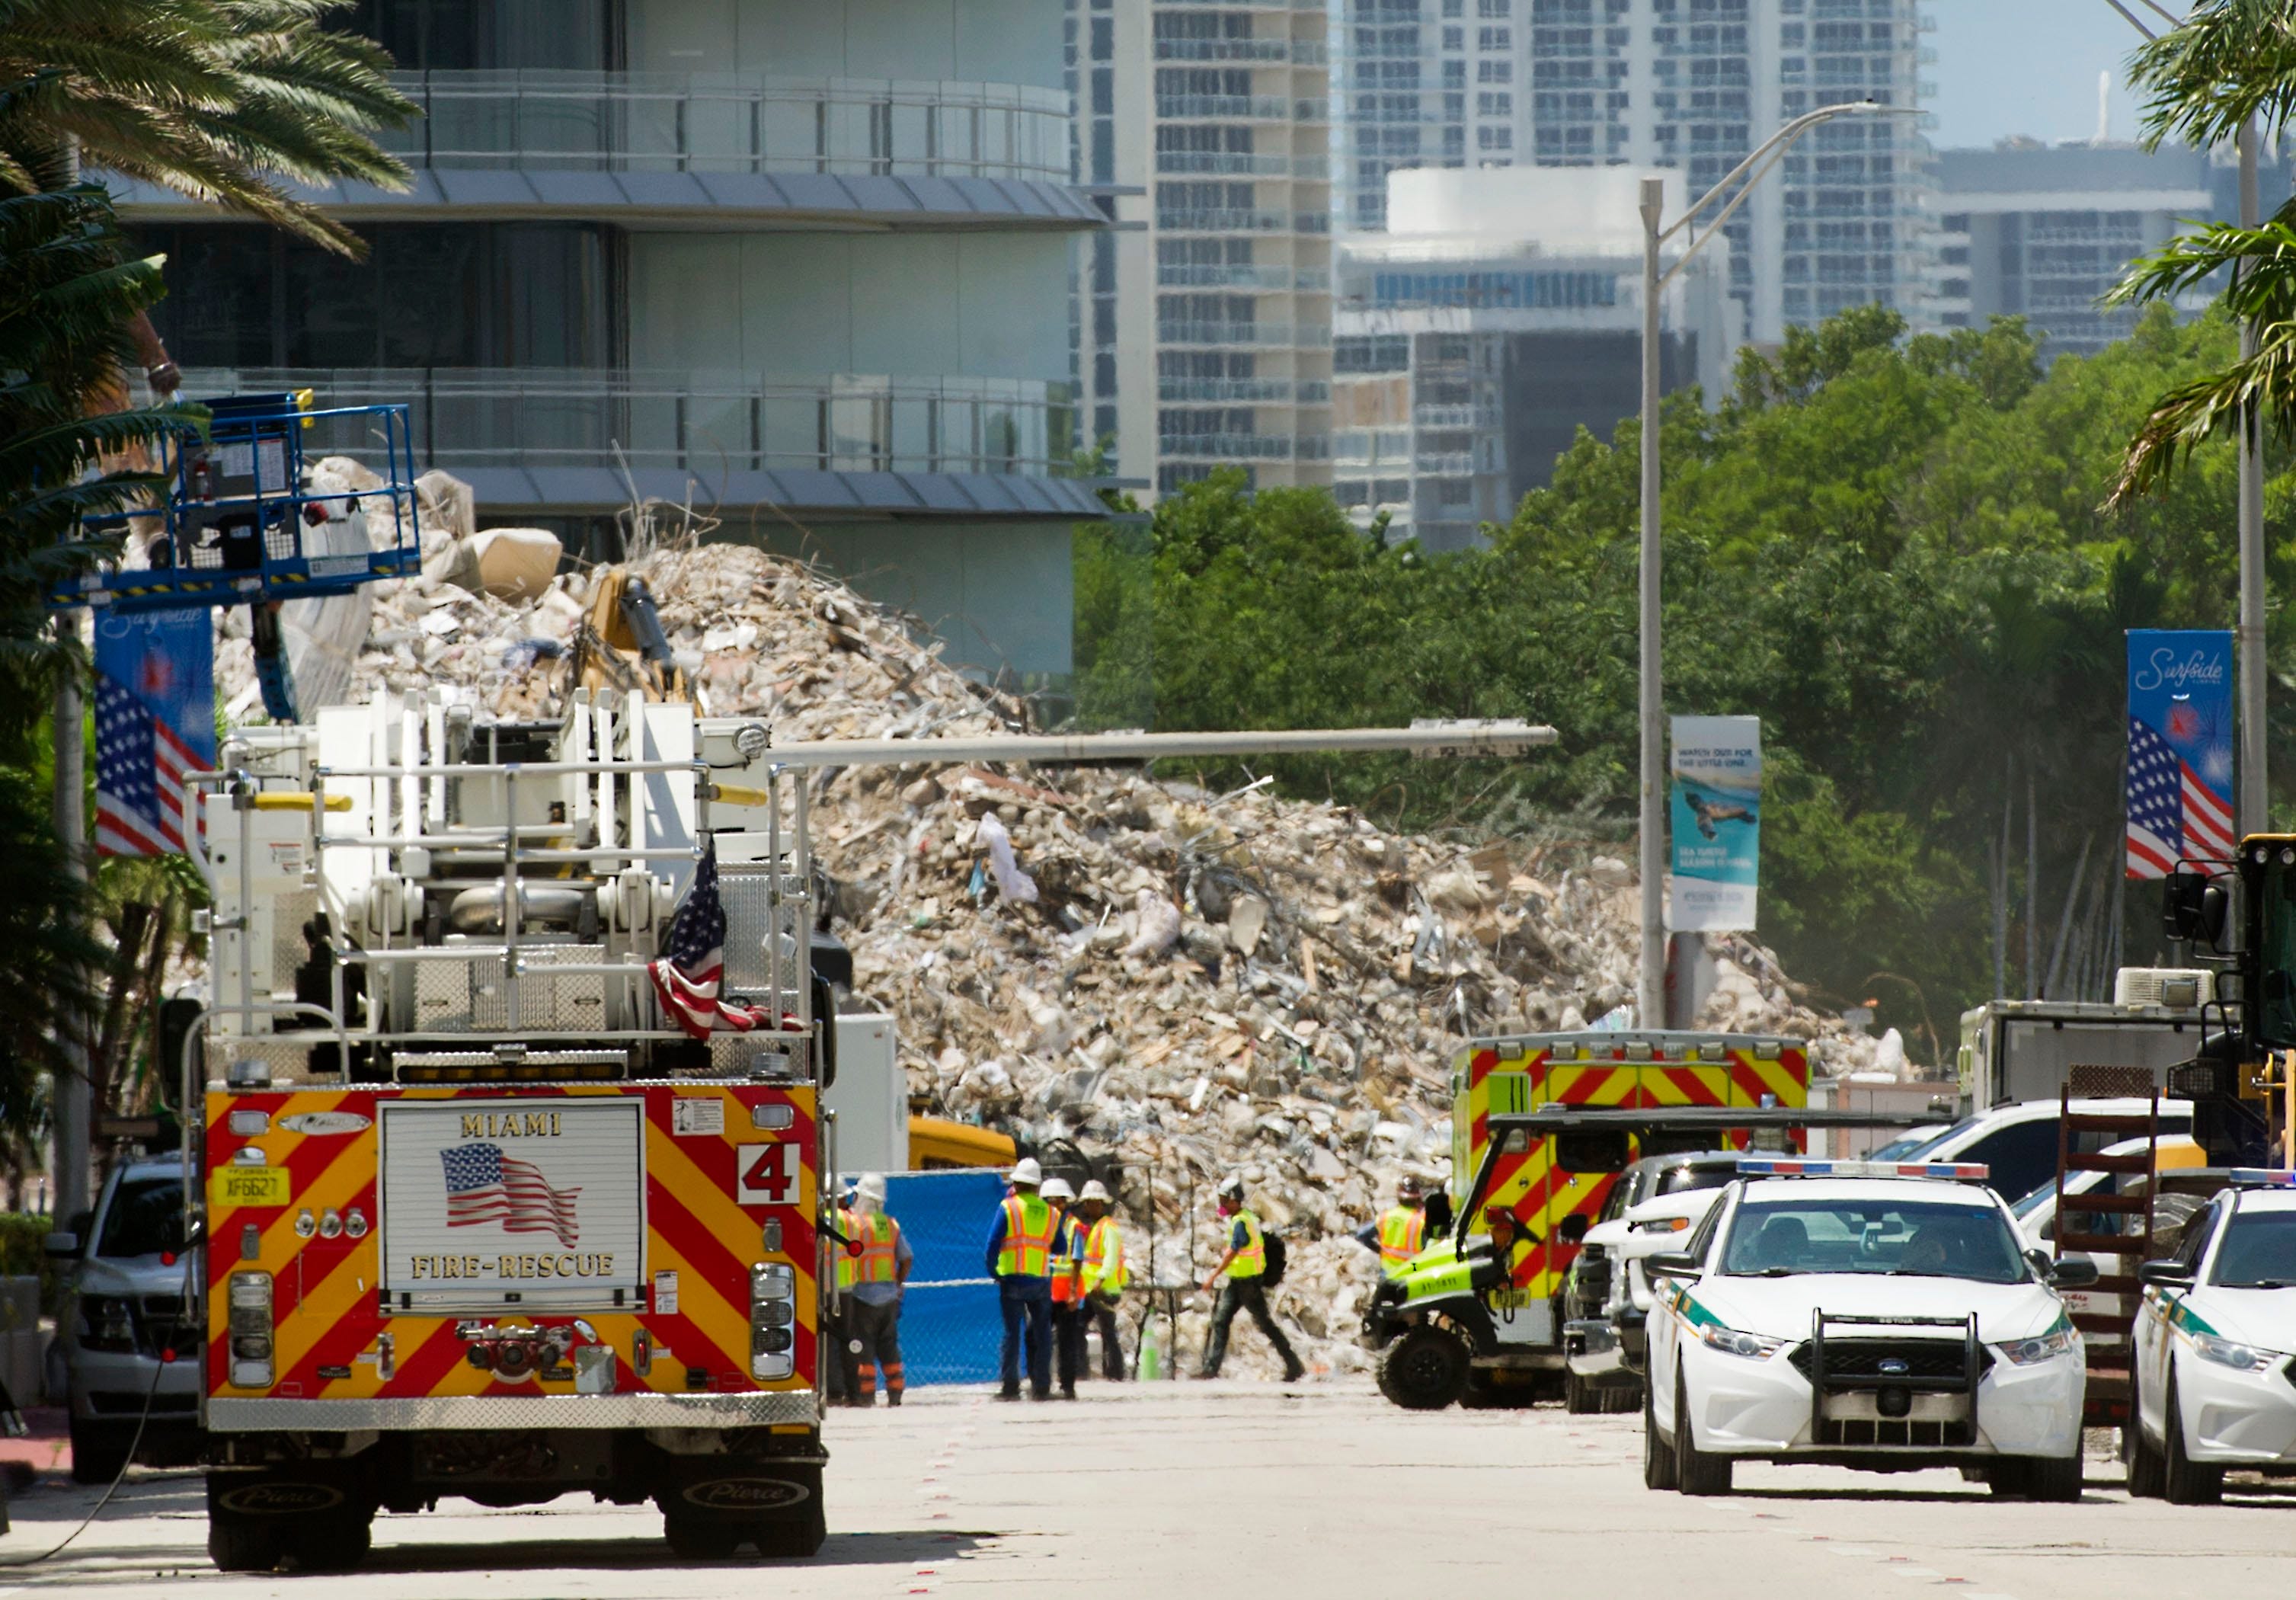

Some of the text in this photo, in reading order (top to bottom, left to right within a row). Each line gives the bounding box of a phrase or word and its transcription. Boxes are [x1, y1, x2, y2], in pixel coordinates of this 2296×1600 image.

[2135, 648, 2223, 690] Surfside
[1713, 748, 1732, 757] OUT
[1735, 748, 1752, 757] FOR
[461, 1112, 561, 1138] MIAMI
[742, 1144, 793, 1202] 4
[412, 1253, 614, 1279] FIRE-RESCUE
[707, 1483, 785, 1502] Pierce
